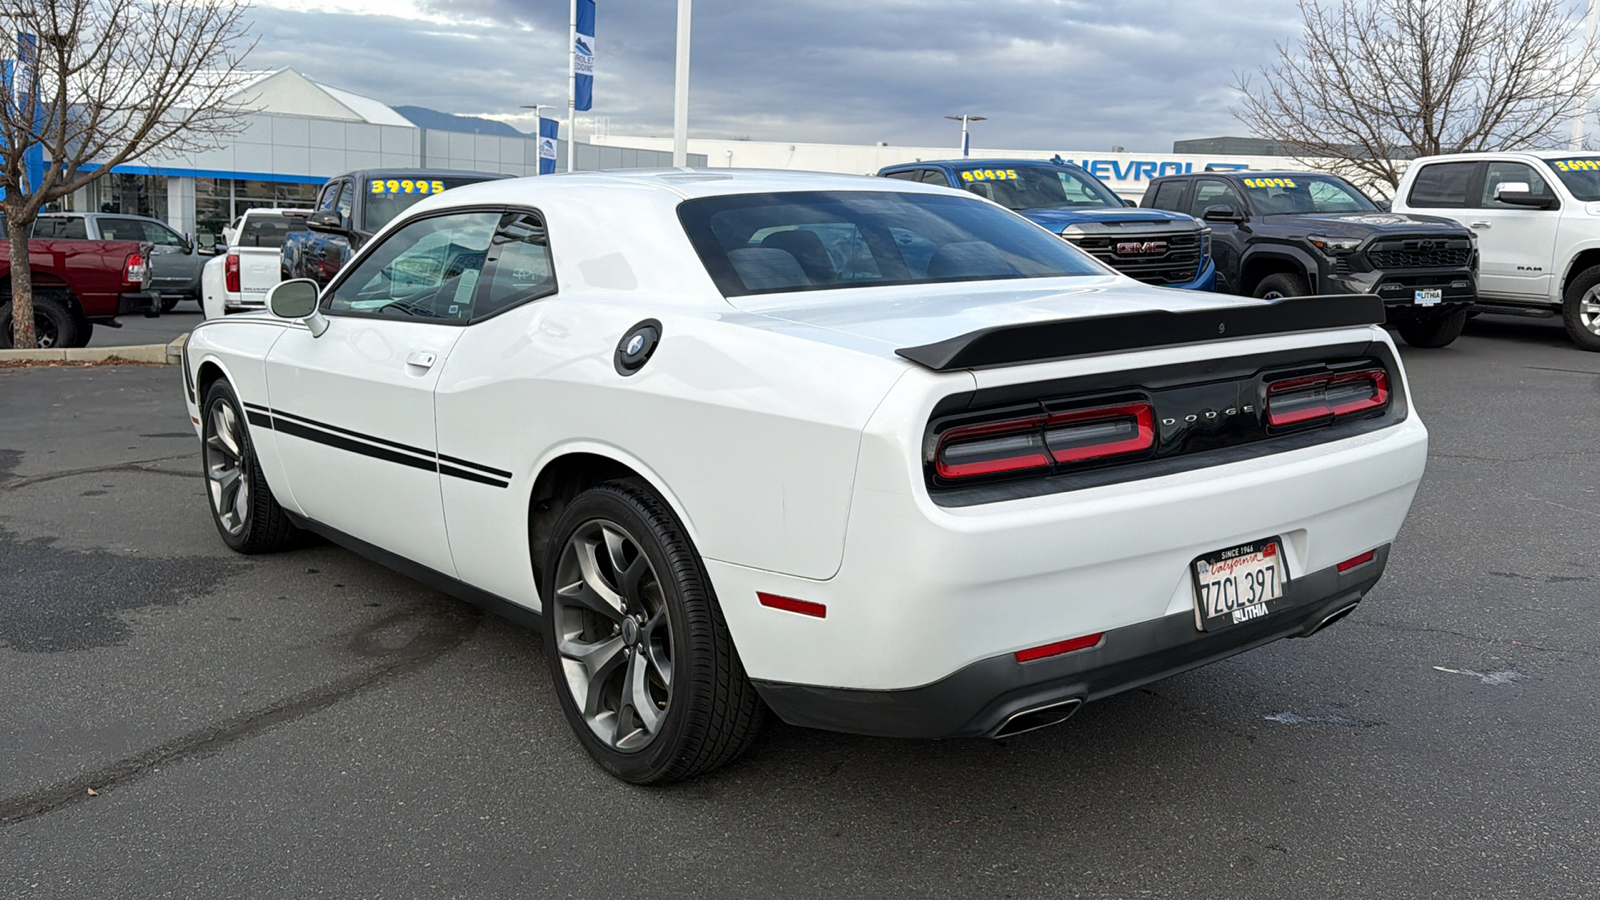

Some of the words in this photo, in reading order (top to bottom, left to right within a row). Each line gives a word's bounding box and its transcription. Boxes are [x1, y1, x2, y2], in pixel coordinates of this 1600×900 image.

[372, 179, 444, 194] 39995
[1244, 178, 1296, 188] 46095
[1117, 241, 1167, 253] GMC
[1162, 405, 1253, 425] DODGE
[1221, 548, 1240, 560] SINCE
[1240, 545, 1254, 556] 1946
[1210, 554, 1264, 576] California
[1201, 565, 1275, 618] 7ZCL397
[1240, 602, 1269, 622] LITHIA
